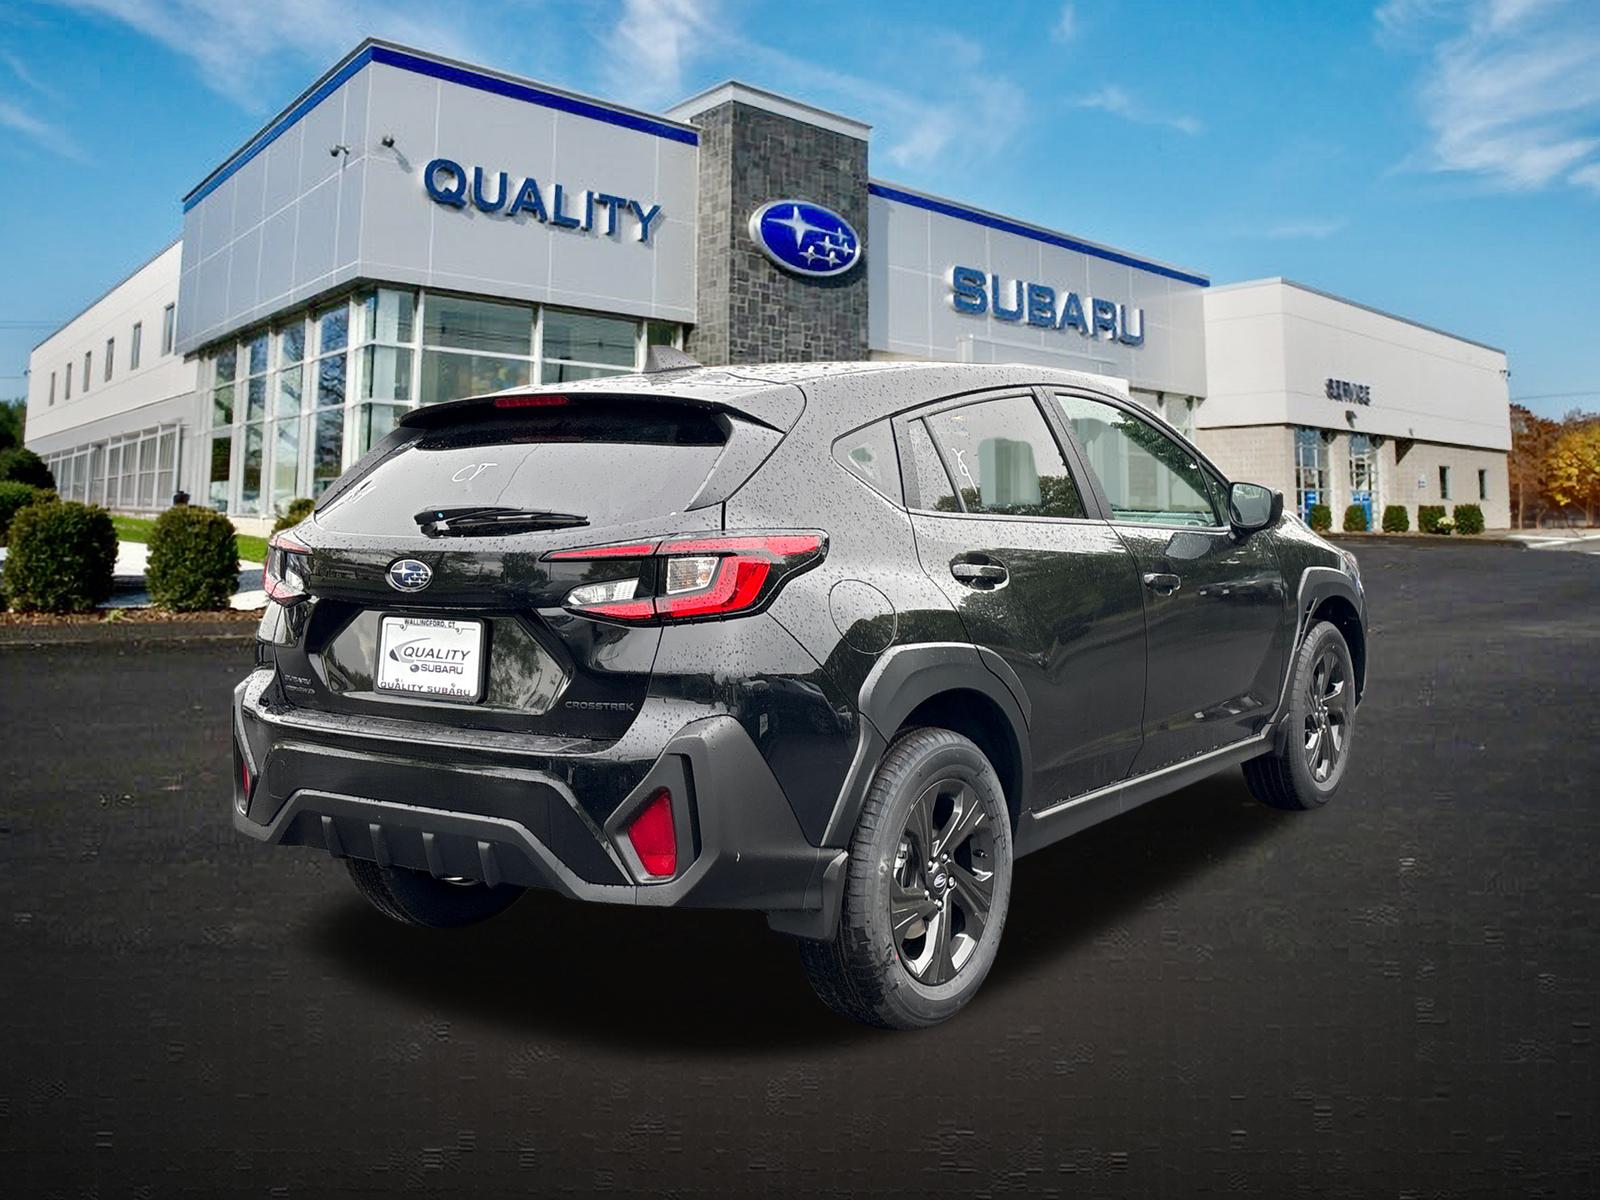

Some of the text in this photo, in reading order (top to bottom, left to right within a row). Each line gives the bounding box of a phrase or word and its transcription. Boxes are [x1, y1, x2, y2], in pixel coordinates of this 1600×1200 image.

[424, 158, 661, 243] QUALITY
[949, 265, 1144, 347] SUBARU
[1325, 378, 1370, 406] SERVICE
[403, 646, 471, 661] QUALITY
[420, 663, 464, 675] SUBARU
[380, 681, 471, 698] QUALITY SUBARU
[564, 701, 635, 711] CROSSTREK
